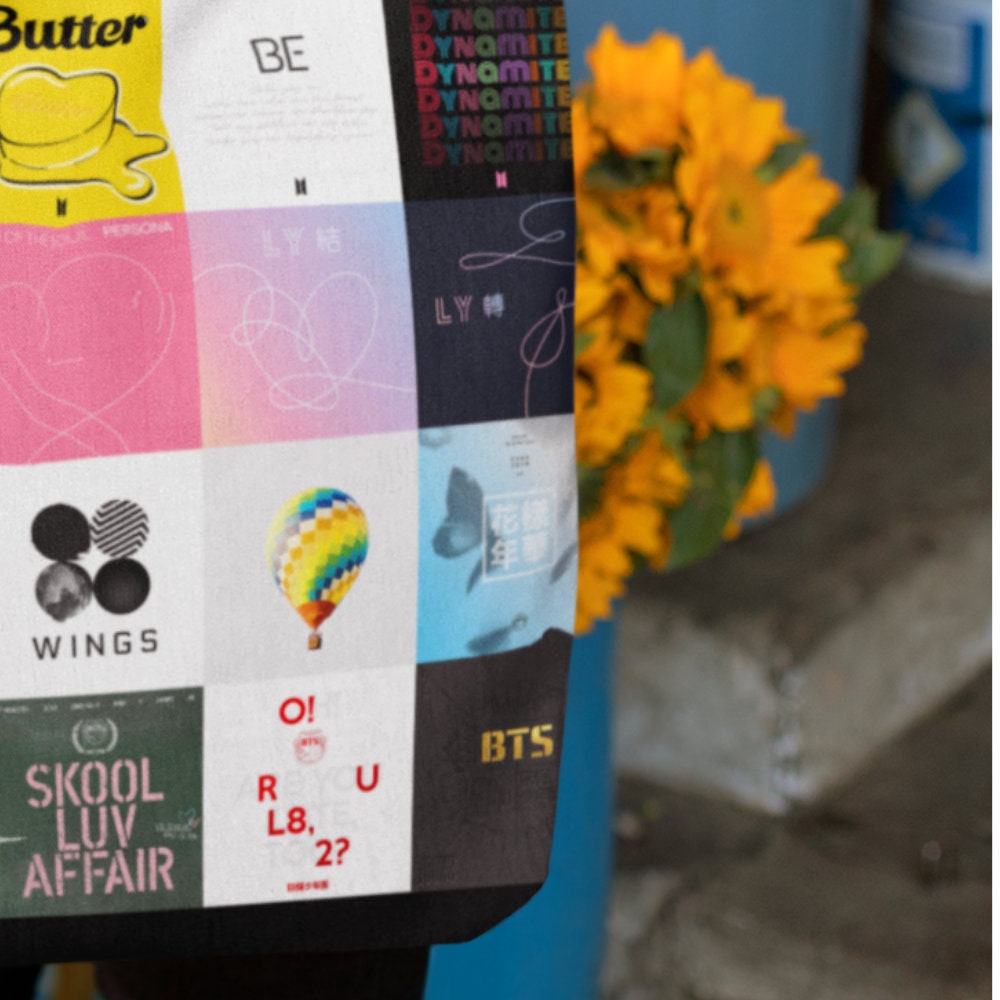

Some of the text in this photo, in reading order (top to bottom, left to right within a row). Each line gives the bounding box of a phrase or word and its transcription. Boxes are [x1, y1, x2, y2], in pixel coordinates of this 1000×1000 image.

[250, 35, 309, 73] BE
[102, 221, 173, 237] PERSONA
[262, 227, 304, 257] LY
[434, 295, 472, 325] LY
[31, 628, 158, 660] WINGS
[278, 694, 315, 725] O!
[481, 723, 554, 763] BTS
[25, 756, 164, 808] SKOOL
[257, 763, 380, 802] R U
[56, 803, 136, 850] LUV
[267, 806, 315, 836] L8,
[315, 836, 350, 867] 2?
[23, 846, 174, 898] AFFAIR
